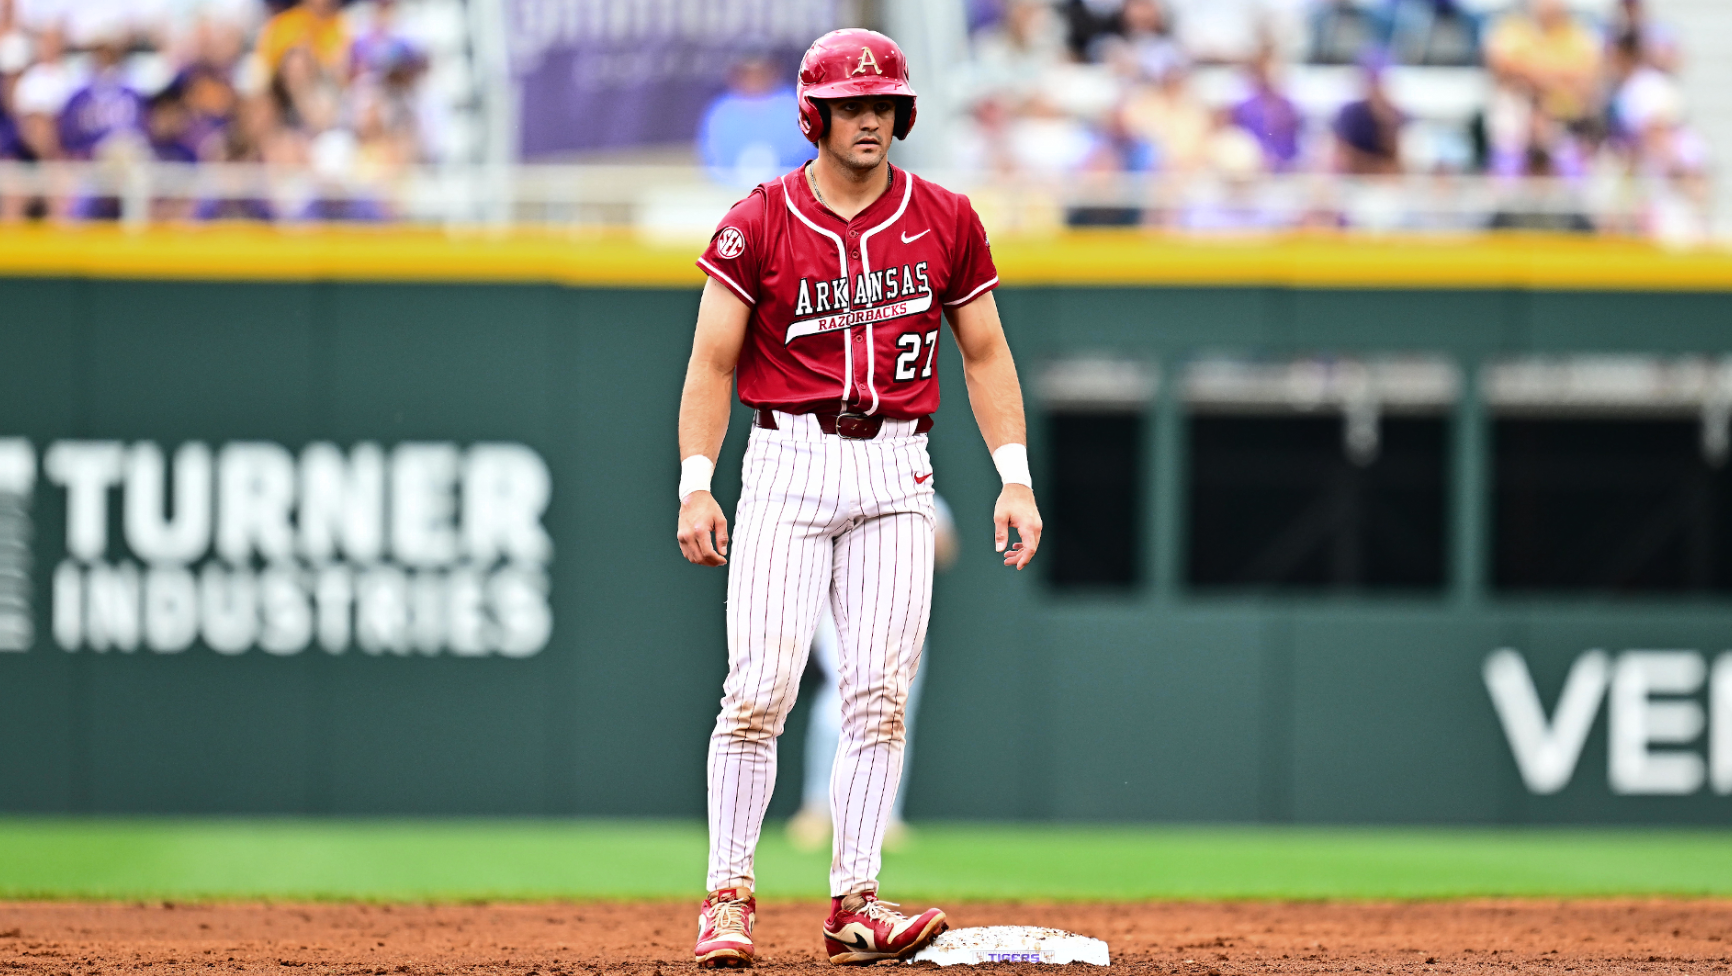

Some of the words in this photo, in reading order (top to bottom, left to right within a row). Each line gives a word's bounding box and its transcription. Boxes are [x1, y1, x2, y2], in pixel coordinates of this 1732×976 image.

[852, 46, 883, 76] A
[718, 228, 743, 257] SEC
[795, 262, 930, 316] ARKANSAS
[818, 302, 907, 332] RAZORBACKS
[893, 330, 938, 383] 27
[45, 441, 552, 568] TURNER
[53, 561, 553, 656] INDUSTRIES
[987, 952, 1041, 963] TIGERS
